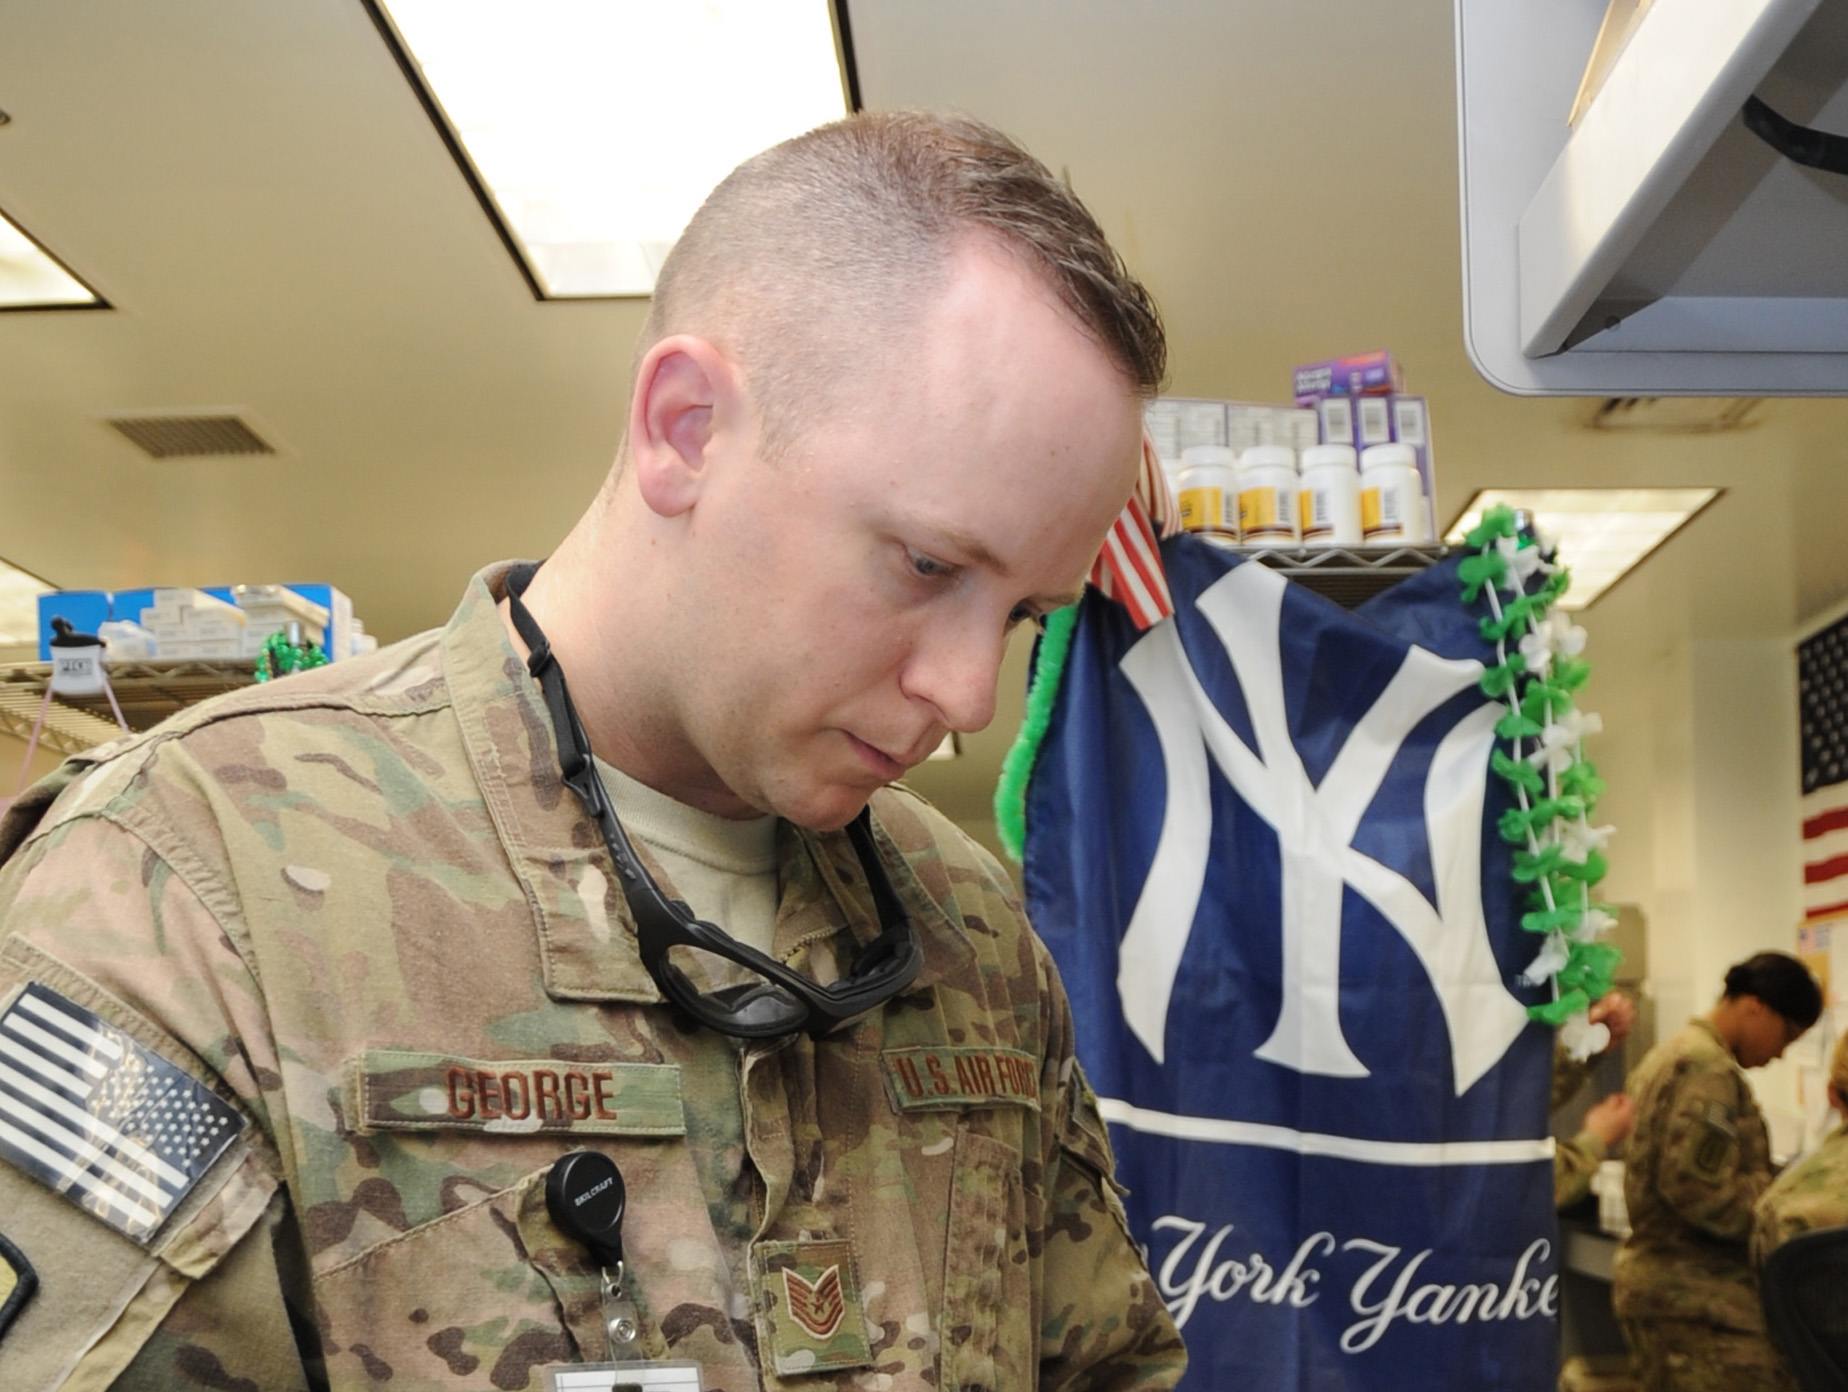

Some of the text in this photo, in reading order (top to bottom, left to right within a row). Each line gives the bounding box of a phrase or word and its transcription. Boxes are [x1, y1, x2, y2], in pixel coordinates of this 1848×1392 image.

[445, 1065, 617, 1120] GEORGE
[896, 1053, 957, 1098] U.S.
[953, 1052, 996, 1096] AIR
[1151, 1215, 1336, 1331] York
